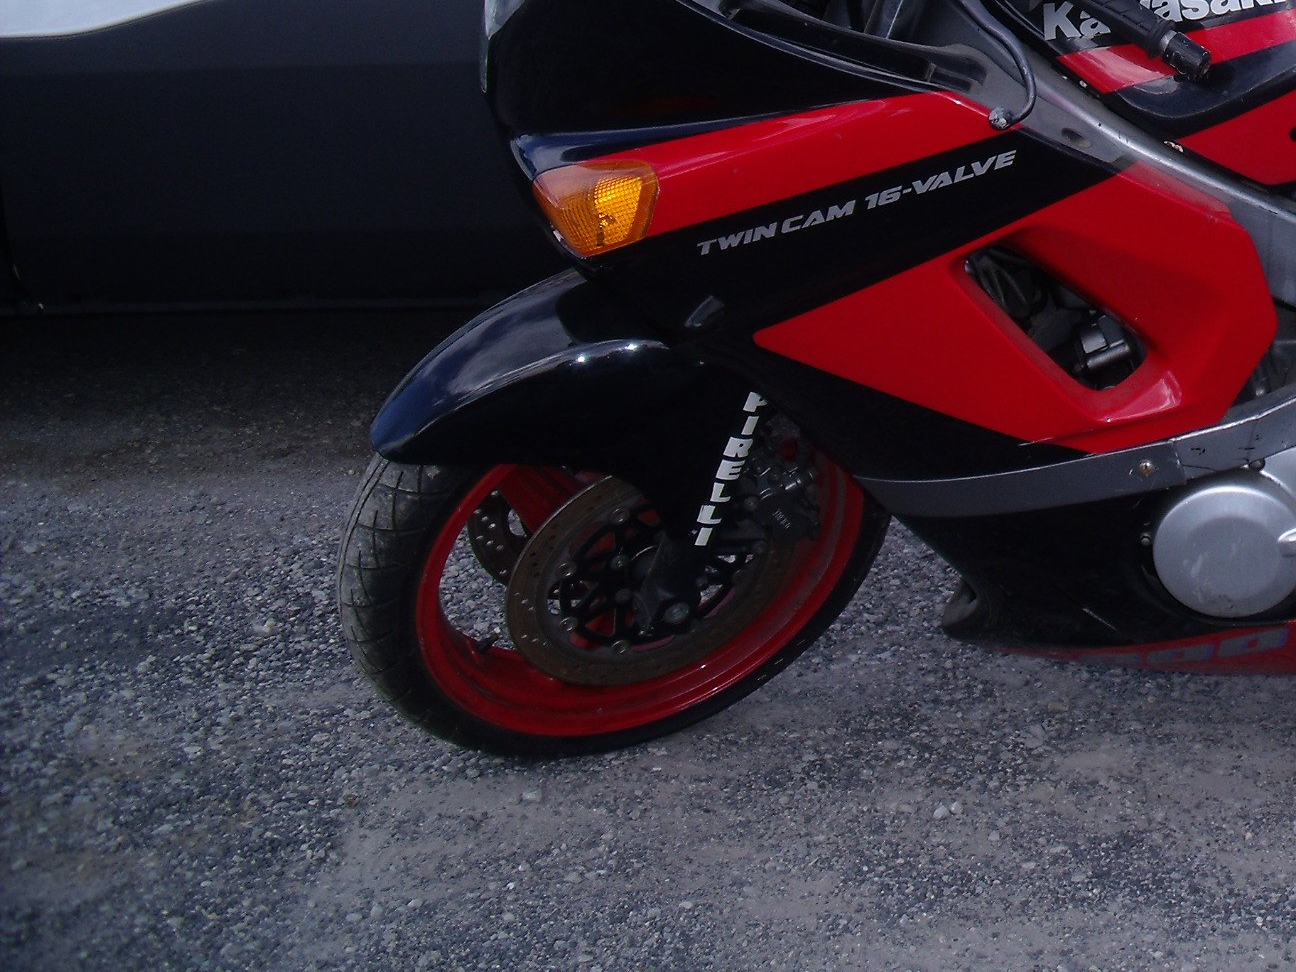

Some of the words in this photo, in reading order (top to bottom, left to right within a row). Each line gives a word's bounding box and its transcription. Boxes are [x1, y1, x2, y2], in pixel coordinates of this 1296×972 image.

[697, 222, 777, 256] TWIN
[780, 199, 856, 231] CAM
[864, 149, 1017, 210] 16-VALVE
[694, 391, 768, 546] PIRELLI
